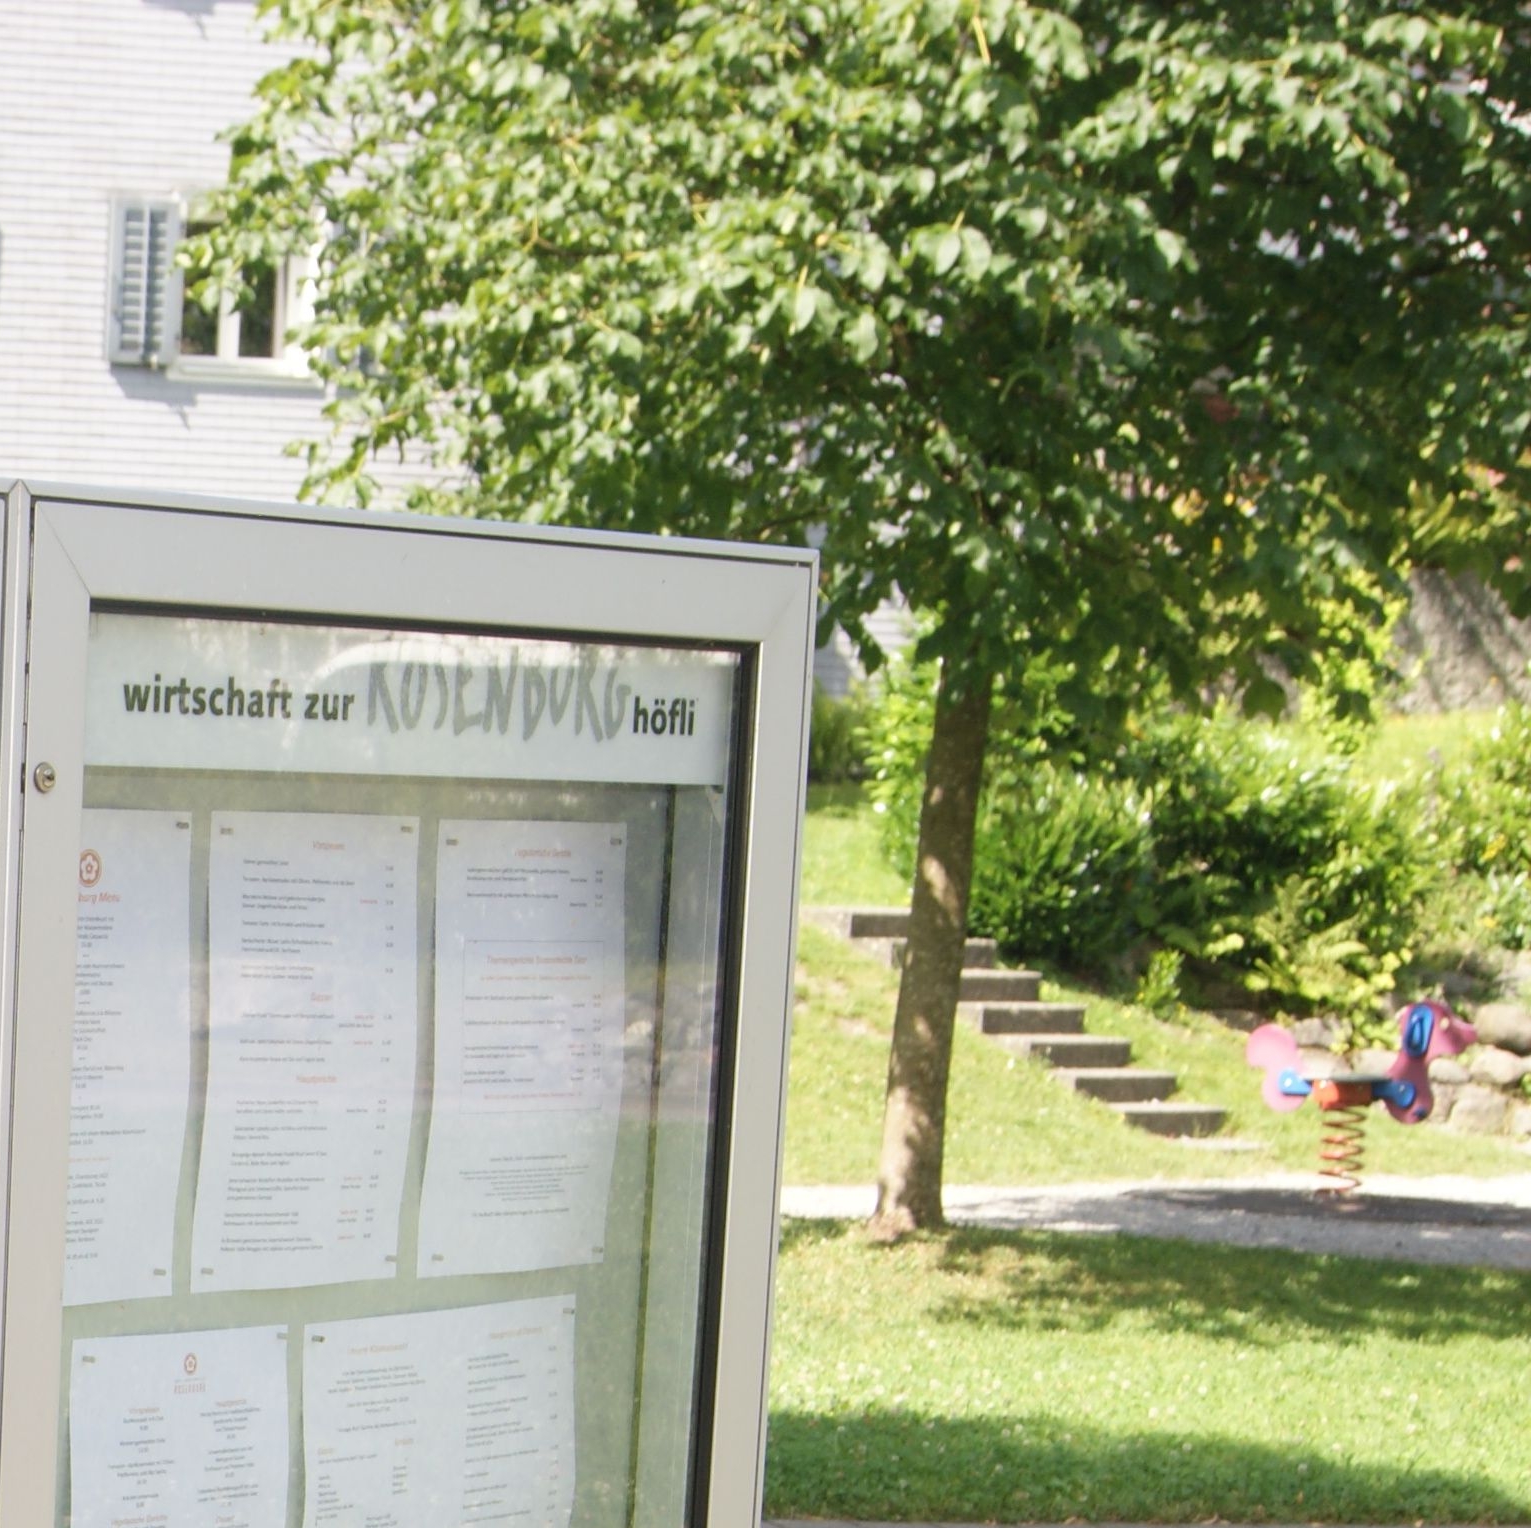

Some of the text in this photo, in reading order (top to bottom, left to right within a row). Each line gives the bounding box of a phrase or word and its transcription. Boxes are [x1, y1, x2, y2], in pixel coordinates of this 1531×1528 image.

[123, 673, 292, 719] wirtschaft
[304, 693, 355, 722] zur
[633, 697, 696, 736] höfli
